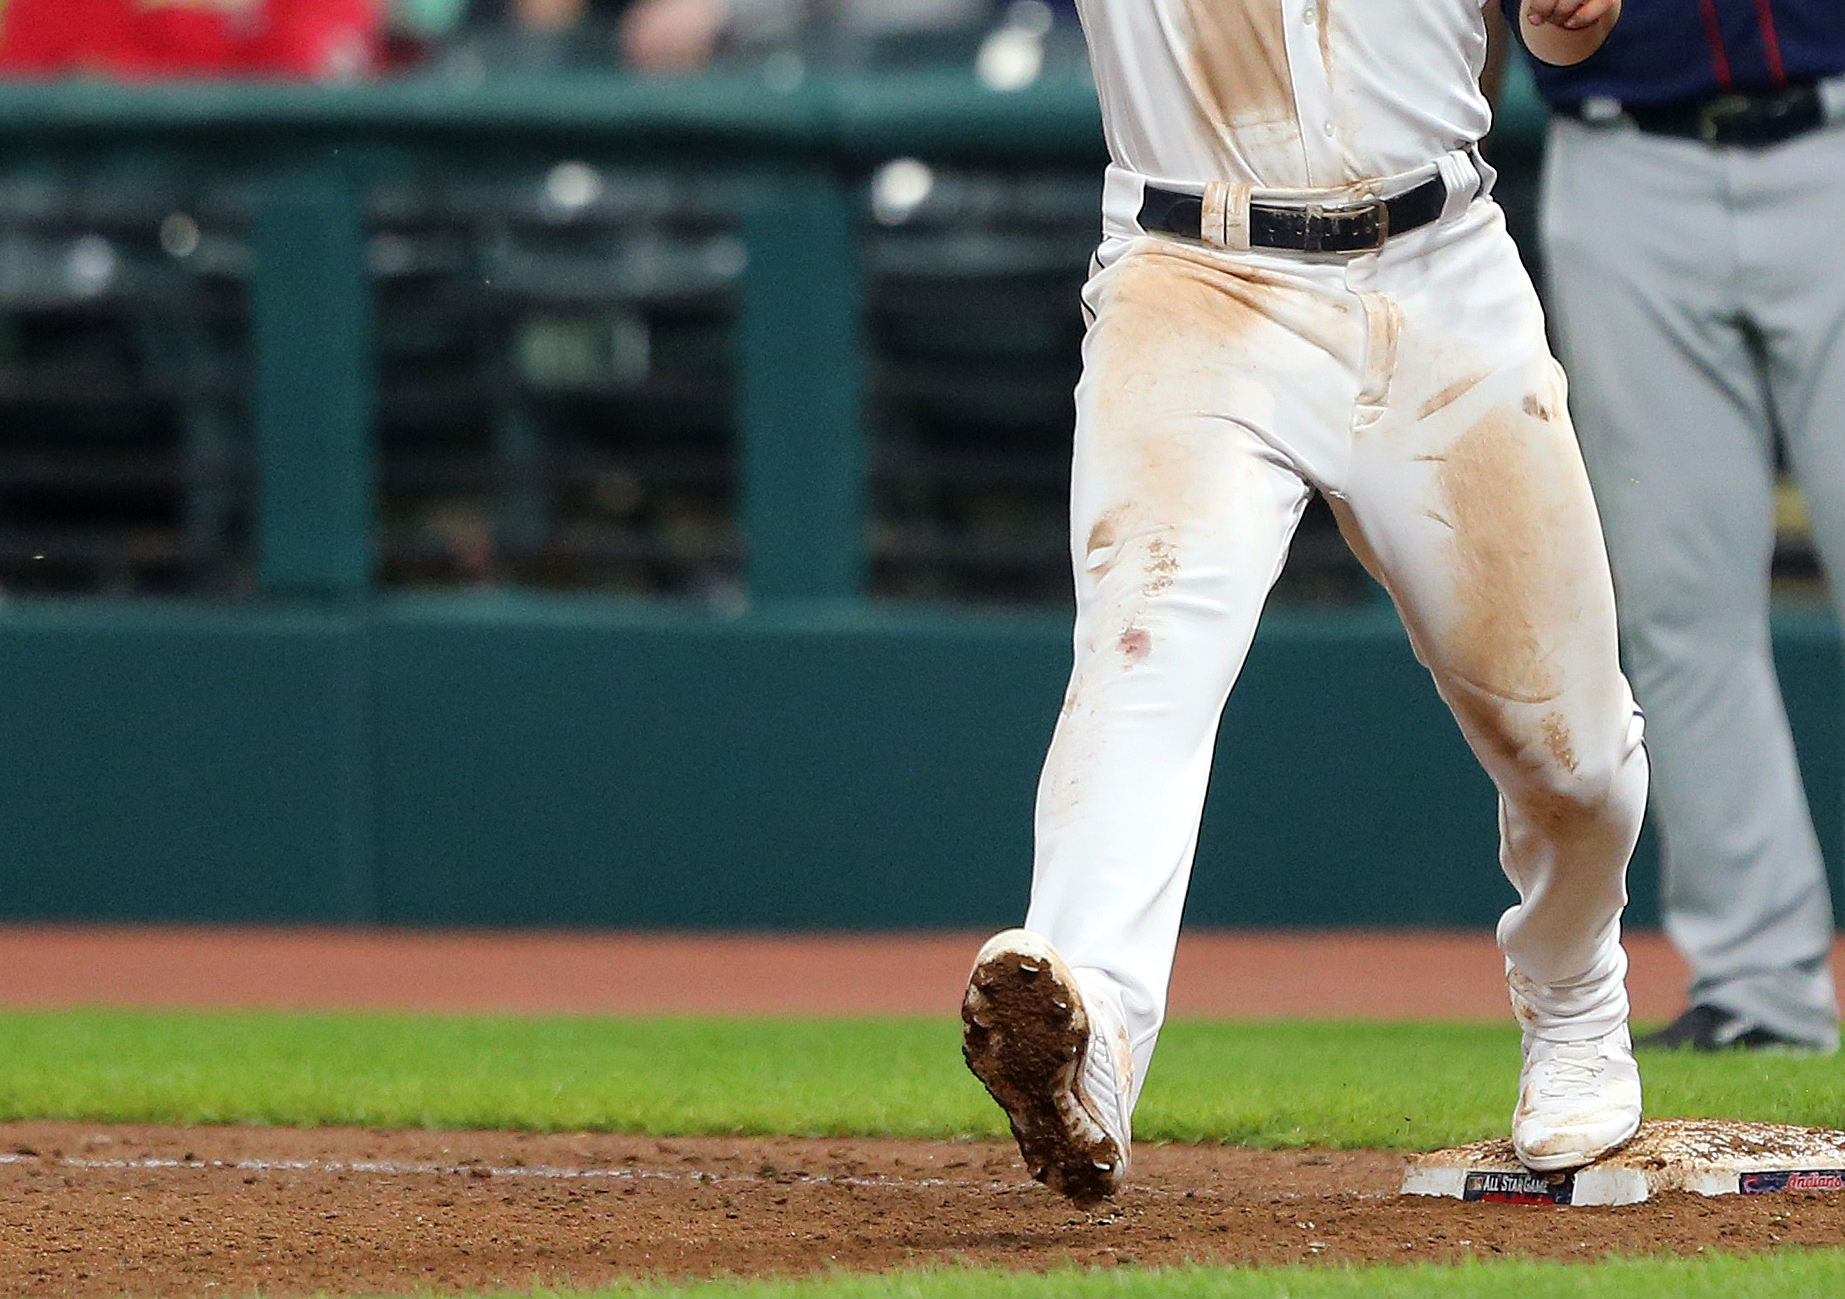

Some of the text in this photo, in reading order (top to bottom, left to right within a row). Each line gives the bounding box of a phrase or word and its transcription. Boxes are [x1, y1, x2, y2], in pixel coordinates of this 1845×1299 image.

[1483, 1174, 1499, 1191] ALL
[1501, 1175, 1523, 1194] STAR
[1786, 1172, 1845, 1190] Indians
